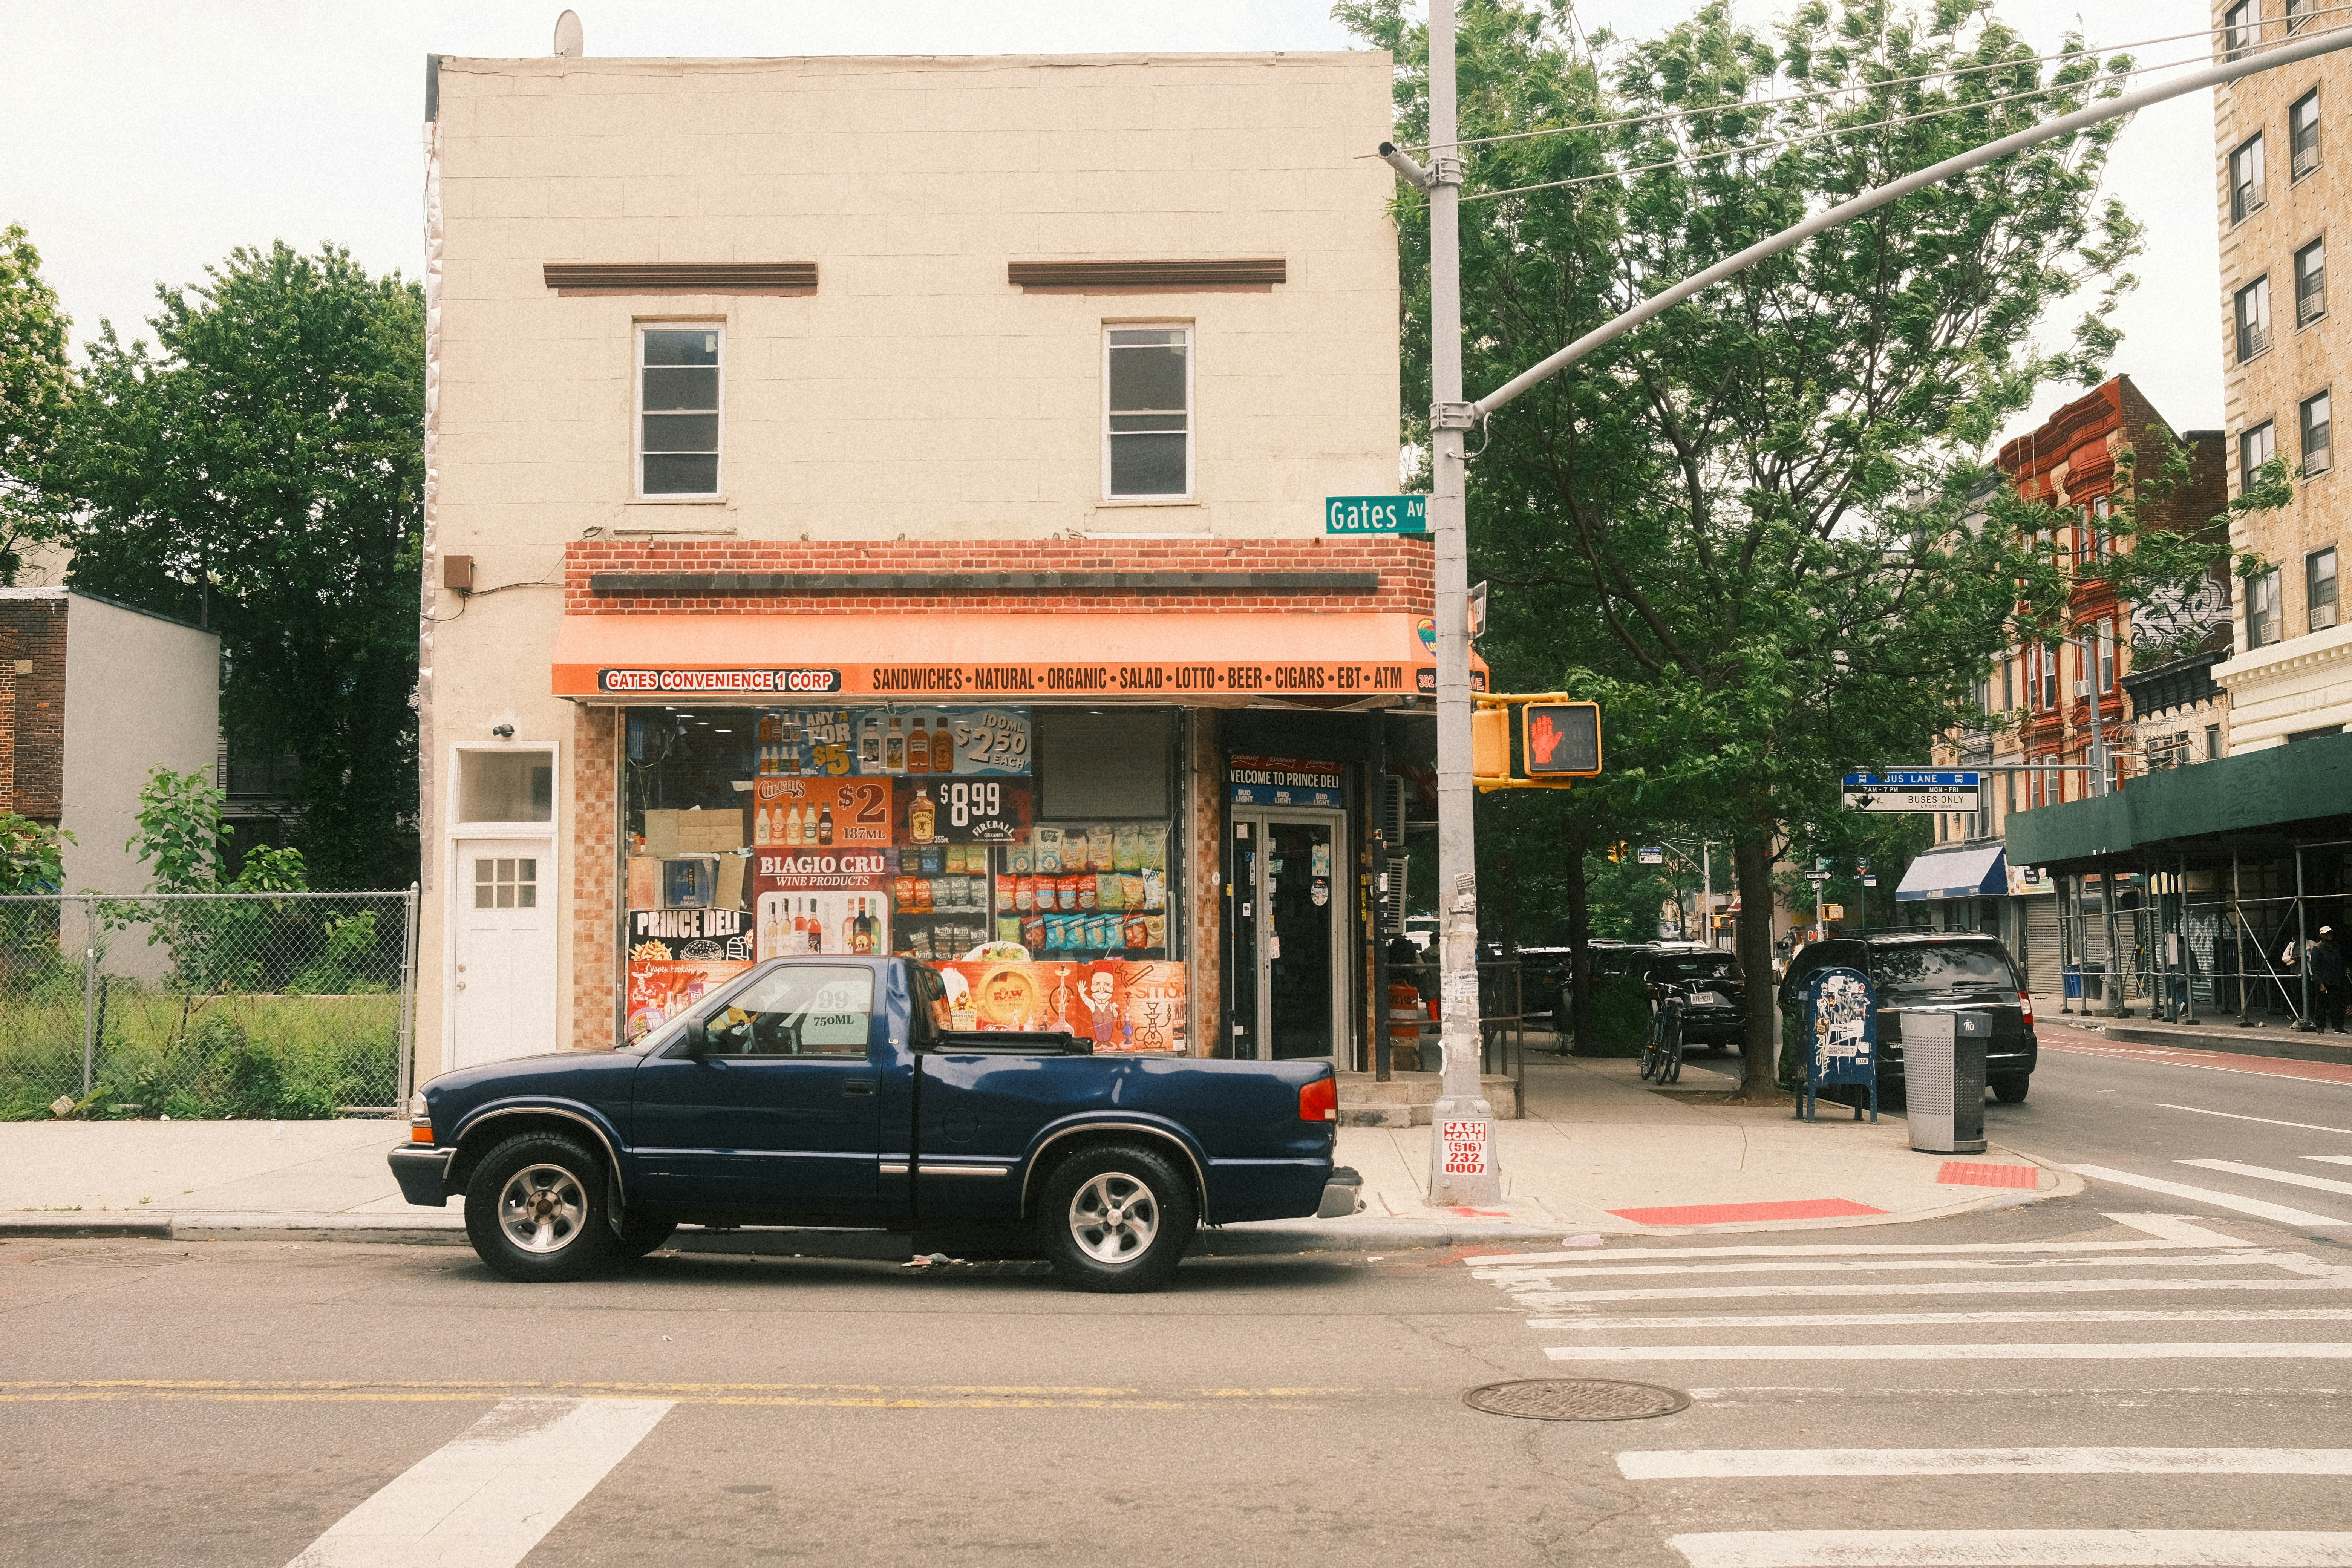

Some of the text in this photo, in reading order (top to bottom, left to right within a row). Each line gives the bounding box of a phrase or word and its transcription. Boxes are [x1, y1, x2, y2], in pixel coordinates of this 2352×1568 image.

[1331, 501, 1396, 529] Gates
[607, 671, 832, 690] GATES CONVENIENCE 1 CORP
[873, 666, 1402, 689] SANDWICHES NATURAL ORGANIC SALAD LOTTO BEER CIGARS EBT ATM
[1418, 675, 1435, 688] 392
[806, 711, 848, 726] ANY 4
[982, 714, 1025, 733] 100ML
[807, 723, 851, 746] FOR
[812, 743, 850, 775] $5
[993, 756, 1026, 769] EACH
[1273, 772, 1284, 785] TO
[1287, 773, 1318, 787] PRINCE
[1321, 775, 1338, 788] DELI
[758, 780, 805, 800] CHI-CHI'S
[838, 784, 887, 824] $2
[842, 827, 885, 839] 187ML
[972, 820, 1015, 838] FIREBALL
[760, 856, 884, 873] BIAGIO CRU
[776, 876, 869, 886] WINE PRODUCTS
[1145, 870, 1160, 883] POP
[637, 910, 740, 938] PRINCE DELI
[729, 965, 737, 975] of
[819, 991, 850, 1009] 99
[993, 989, 1024, 1001] RAW
[814, 1015, 854, 1027] 750ML
[1449, 1142, 1482, 1152] (516)
[1450, 1153, 1479, 1162] 232
[1445, 1163, 1485, 1173] 0007
